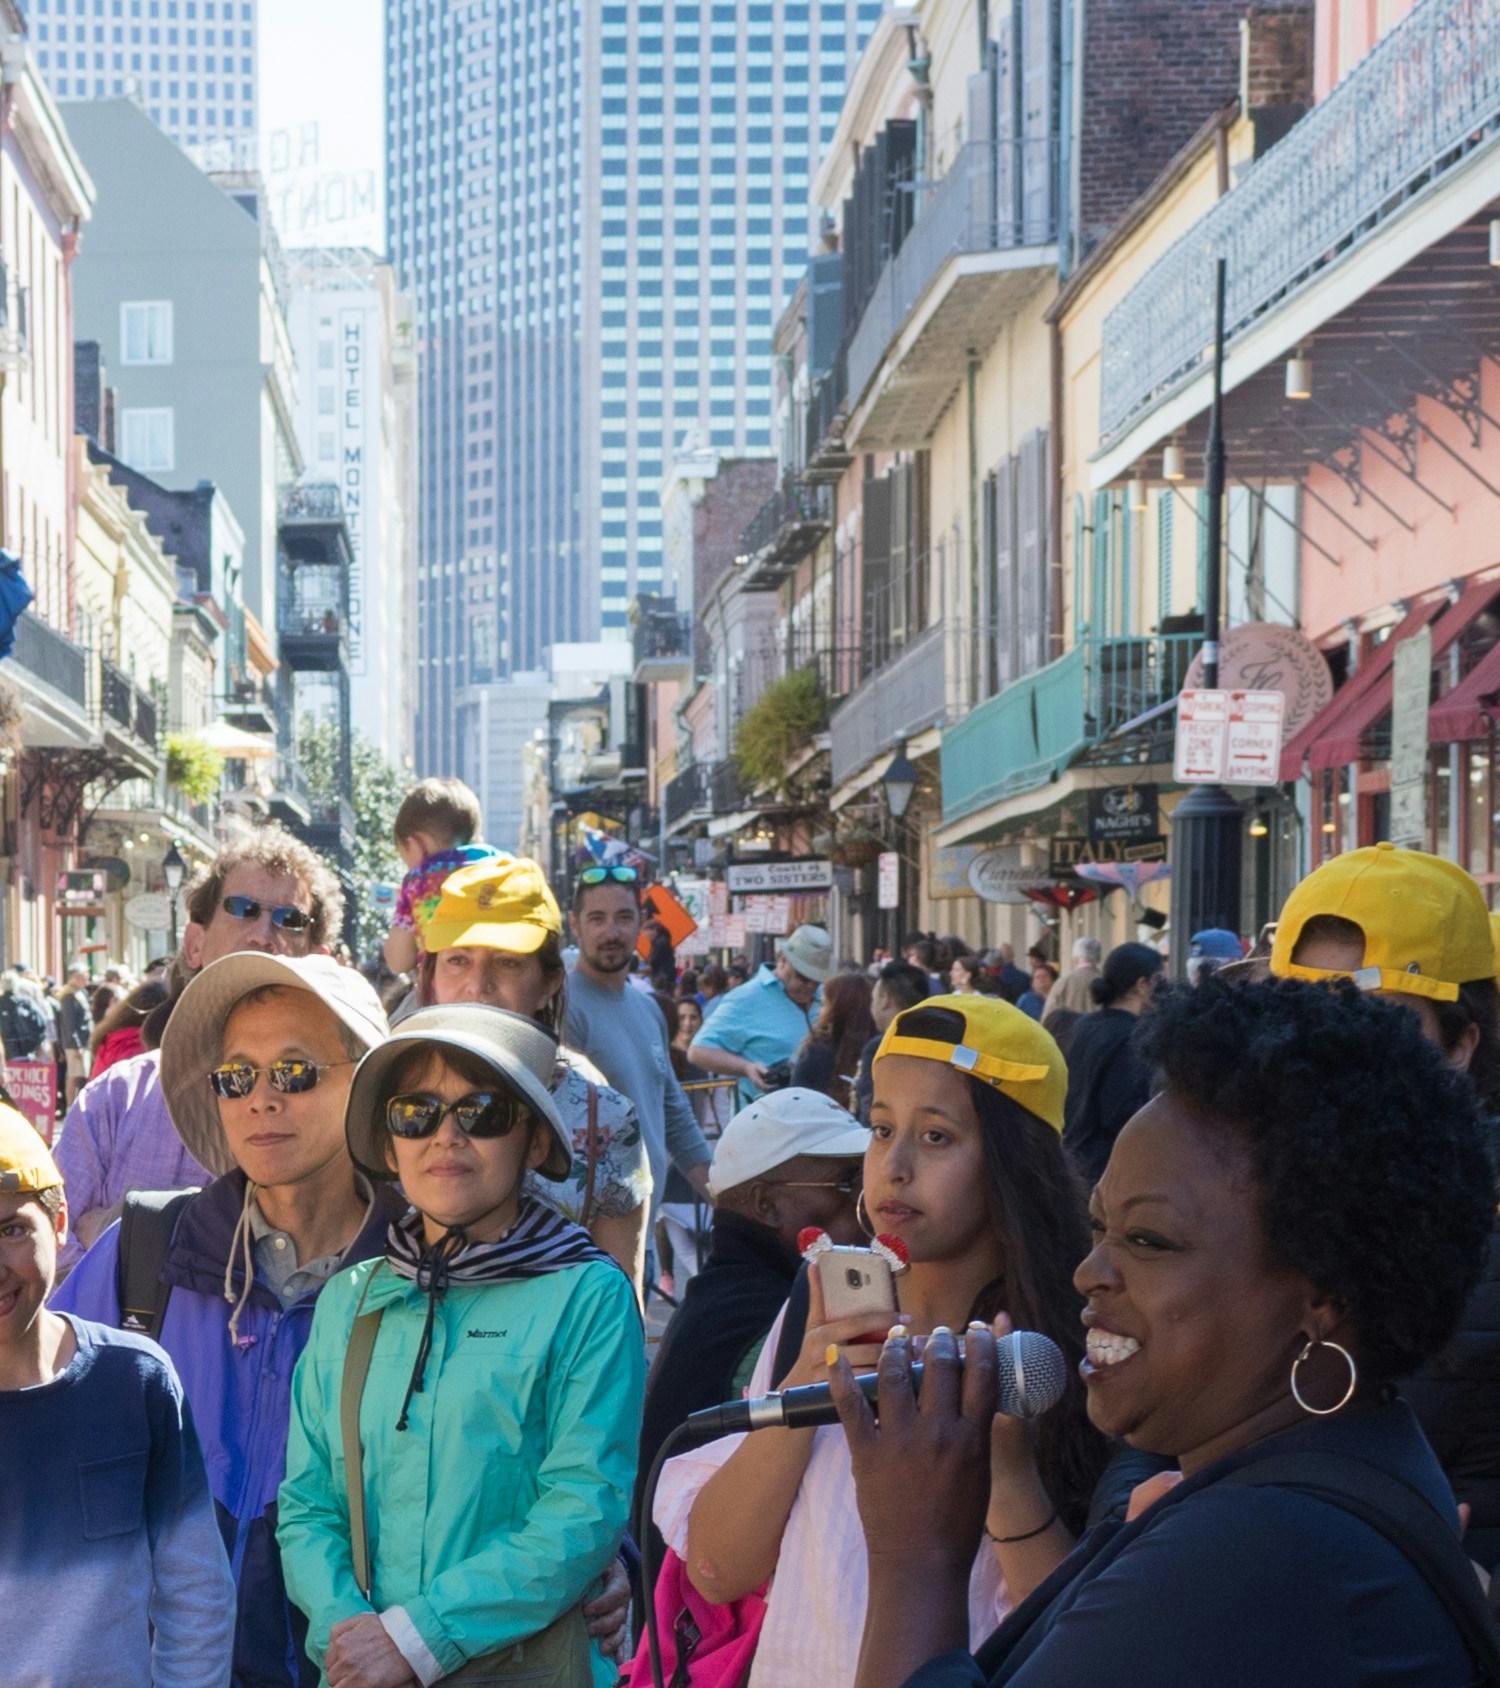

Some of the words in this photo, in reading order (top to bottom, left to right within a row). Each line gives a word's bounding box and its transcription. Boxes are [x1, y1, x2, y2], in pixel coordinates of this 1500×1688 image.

[344, 323, 362, 430] HOTEL
[344, 448, 362, 660] MONTEEONE
[1183, 725, 1220, 735] FREIGHT
[1248, 725, 1259, 735] TO
[1231, 739, 1272, 748] CORNER
[1229, 767, 1273, 777] ANYTIME
[1055, 840, 1128, 863] ITALY
[734, 876, 764, 886] TWO
[770, 872, 827, 884] SISTERS
[466, 1329, 508, 1338] Marmot
